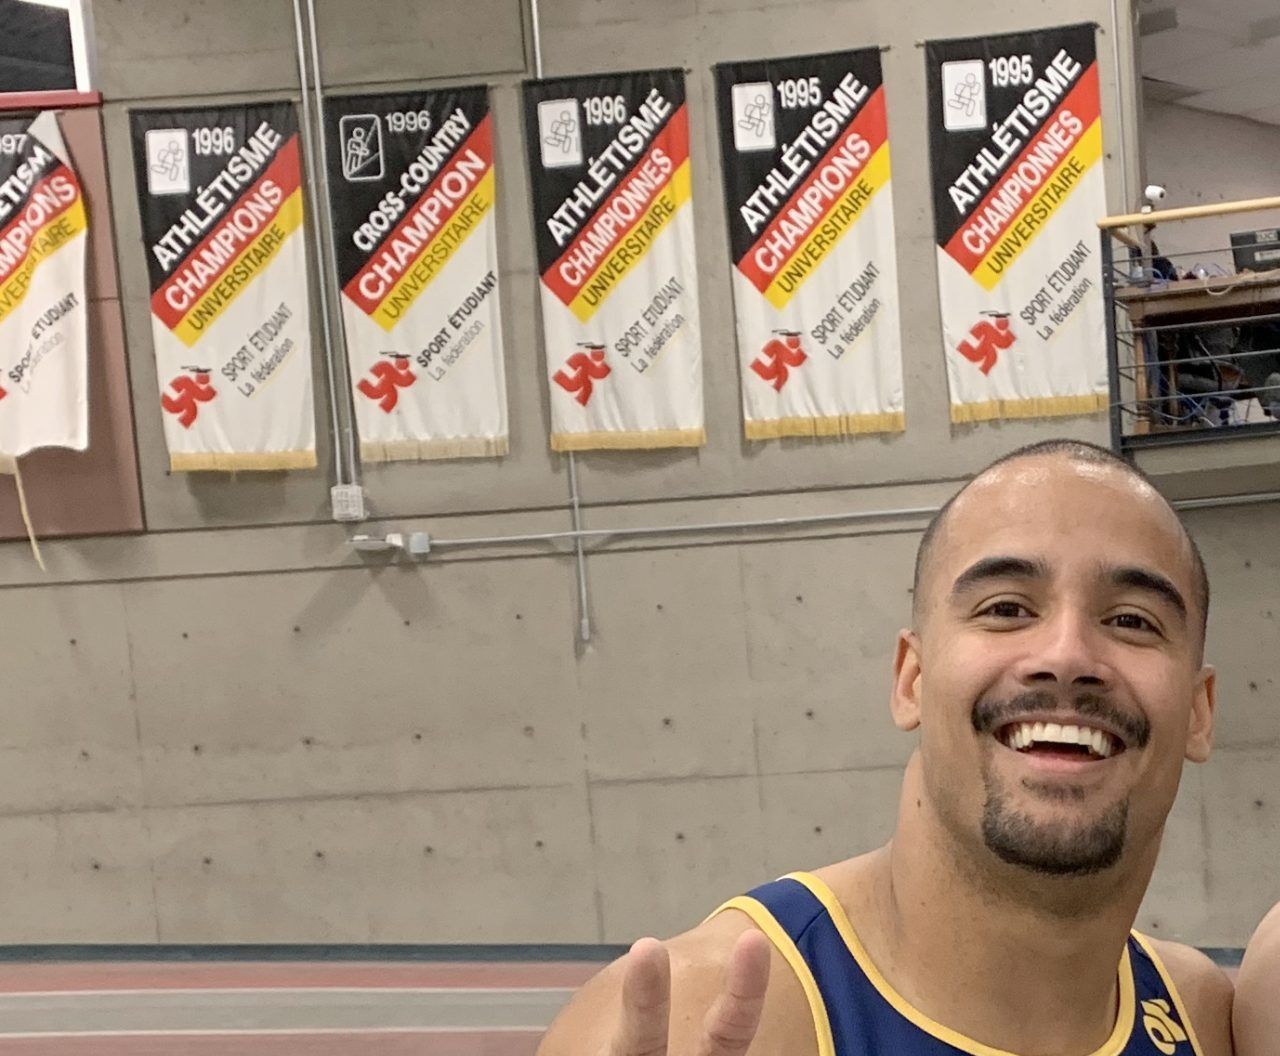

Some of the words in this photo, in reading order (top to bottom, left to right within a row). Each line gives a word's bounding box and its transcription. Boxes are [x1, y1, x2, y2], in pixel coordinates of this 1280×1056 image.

[385, 111, 430, 132] 1996
[583, 95, 627, 126] 1996
[777, 77, 822, 109] 1995
[989, 55, 1034, 87] 1995
[0, 133, 28, 154] 97
[192, 127, 234, 155] 1996
[353, 108, 472, 251] CROSS-COUNTRY
[546, 88, 672, 246] ATHLÉTISME
[739, 72, 869, 233] ATHLÉTISME
[948, 48, 1082, 214] ATHLÉTISME
[962, 109, 1083, 255] CHAMPIONNES
[152, 121, 282, 271] ATHLÉTISME
[166, 180, 282, 311] CHAMPIONS
[359, 149, 486, 300] CHAMPION
[559, 148, 673, 287] CHAMPIONNES
[582, 194, 677, 307] UNIVERSITAIRE
[755, 133, 871, 274] CHAMPIONS
[778, 178, 874, 294] UNIVERSITAIRE
[986, 156, 1085, 275] UNIVERSITAIRE
[188, 225, 285, 331] UNIVERSITAIRE
[382, 193, 490, 319] UNIVERSITAIRE
[1020, 287, 1053, 325] SPORT
[221, 345, 255, 381] SPORT
[416, 327, 451, 367] SPORT
[615, 320, 648, 357] SPORT
[811, 306, 844, 344] SPORT
